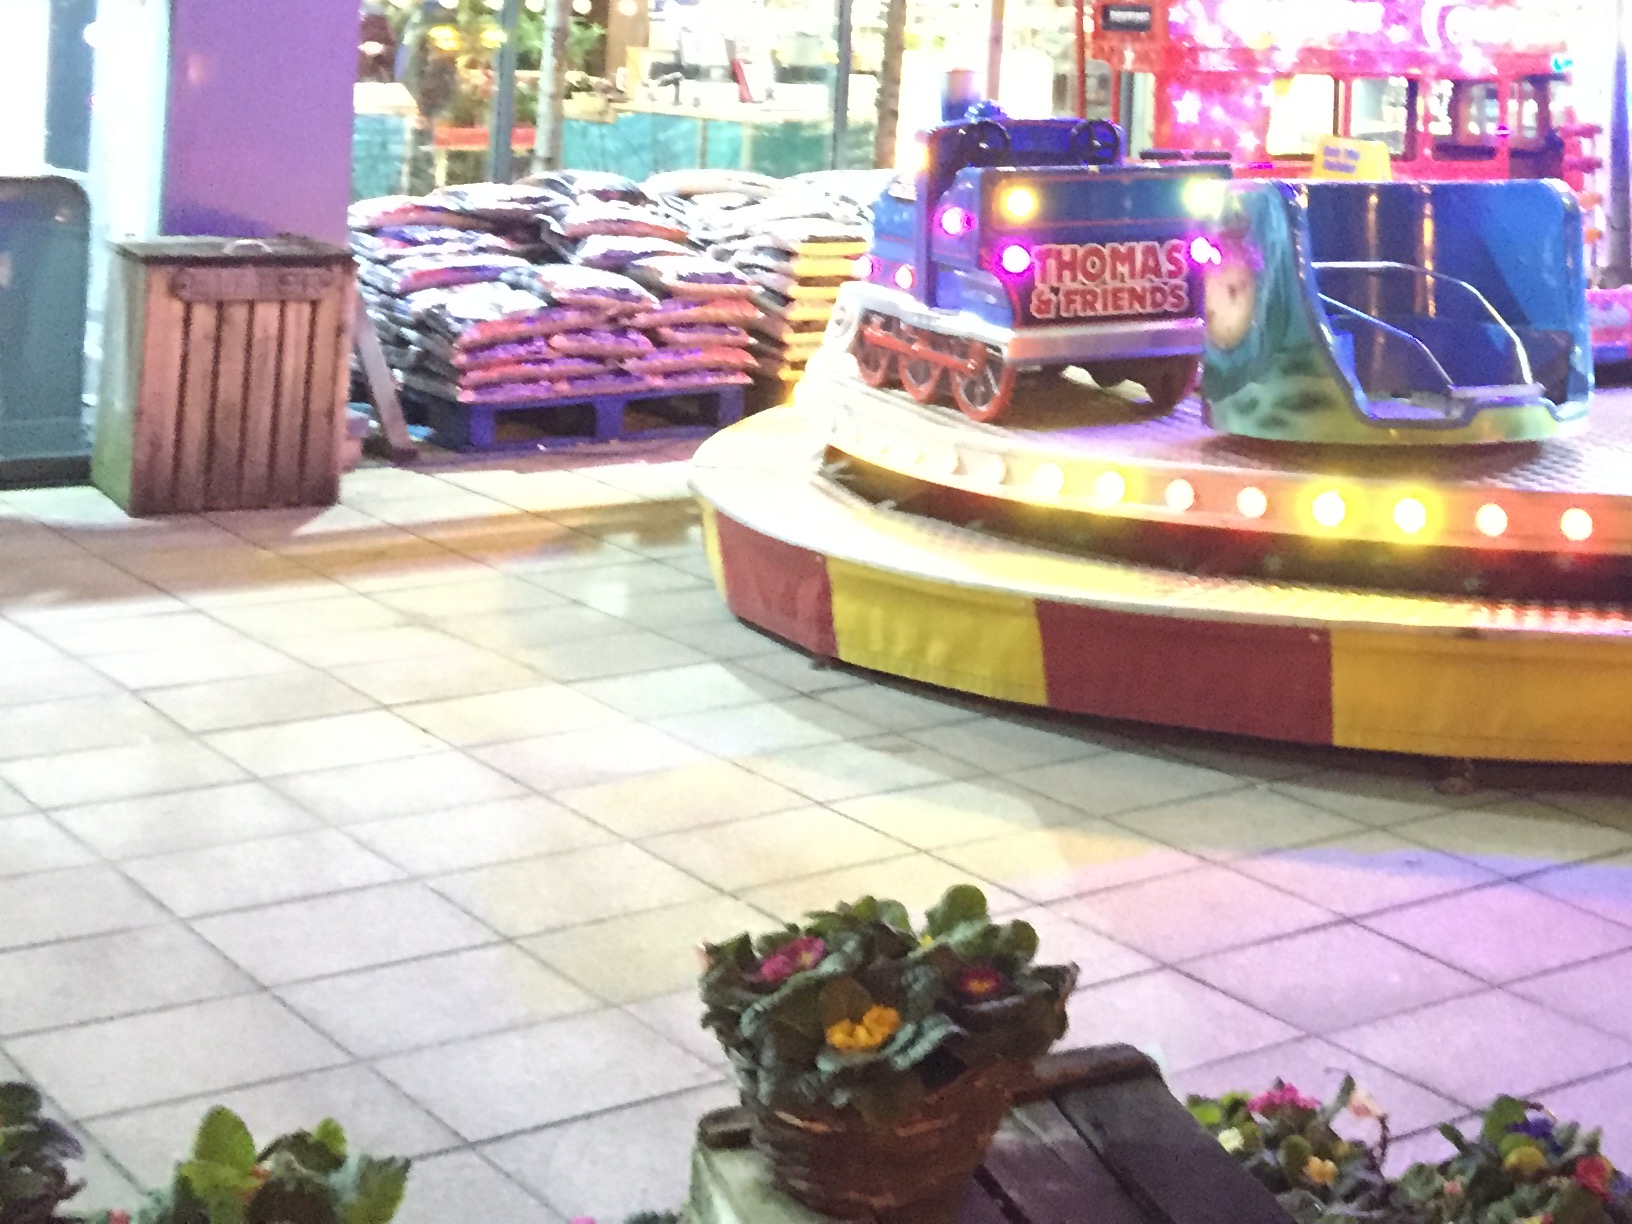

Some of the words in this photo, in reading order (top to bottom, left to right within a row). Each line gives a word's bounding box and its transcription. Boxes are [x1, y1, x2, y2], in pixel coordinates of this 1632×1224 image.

[1033, 240, 1187, 286] THOMAS
[1030, 288, 1057, 319] &
[1060, 279, 1190, 317] FRIENDS
